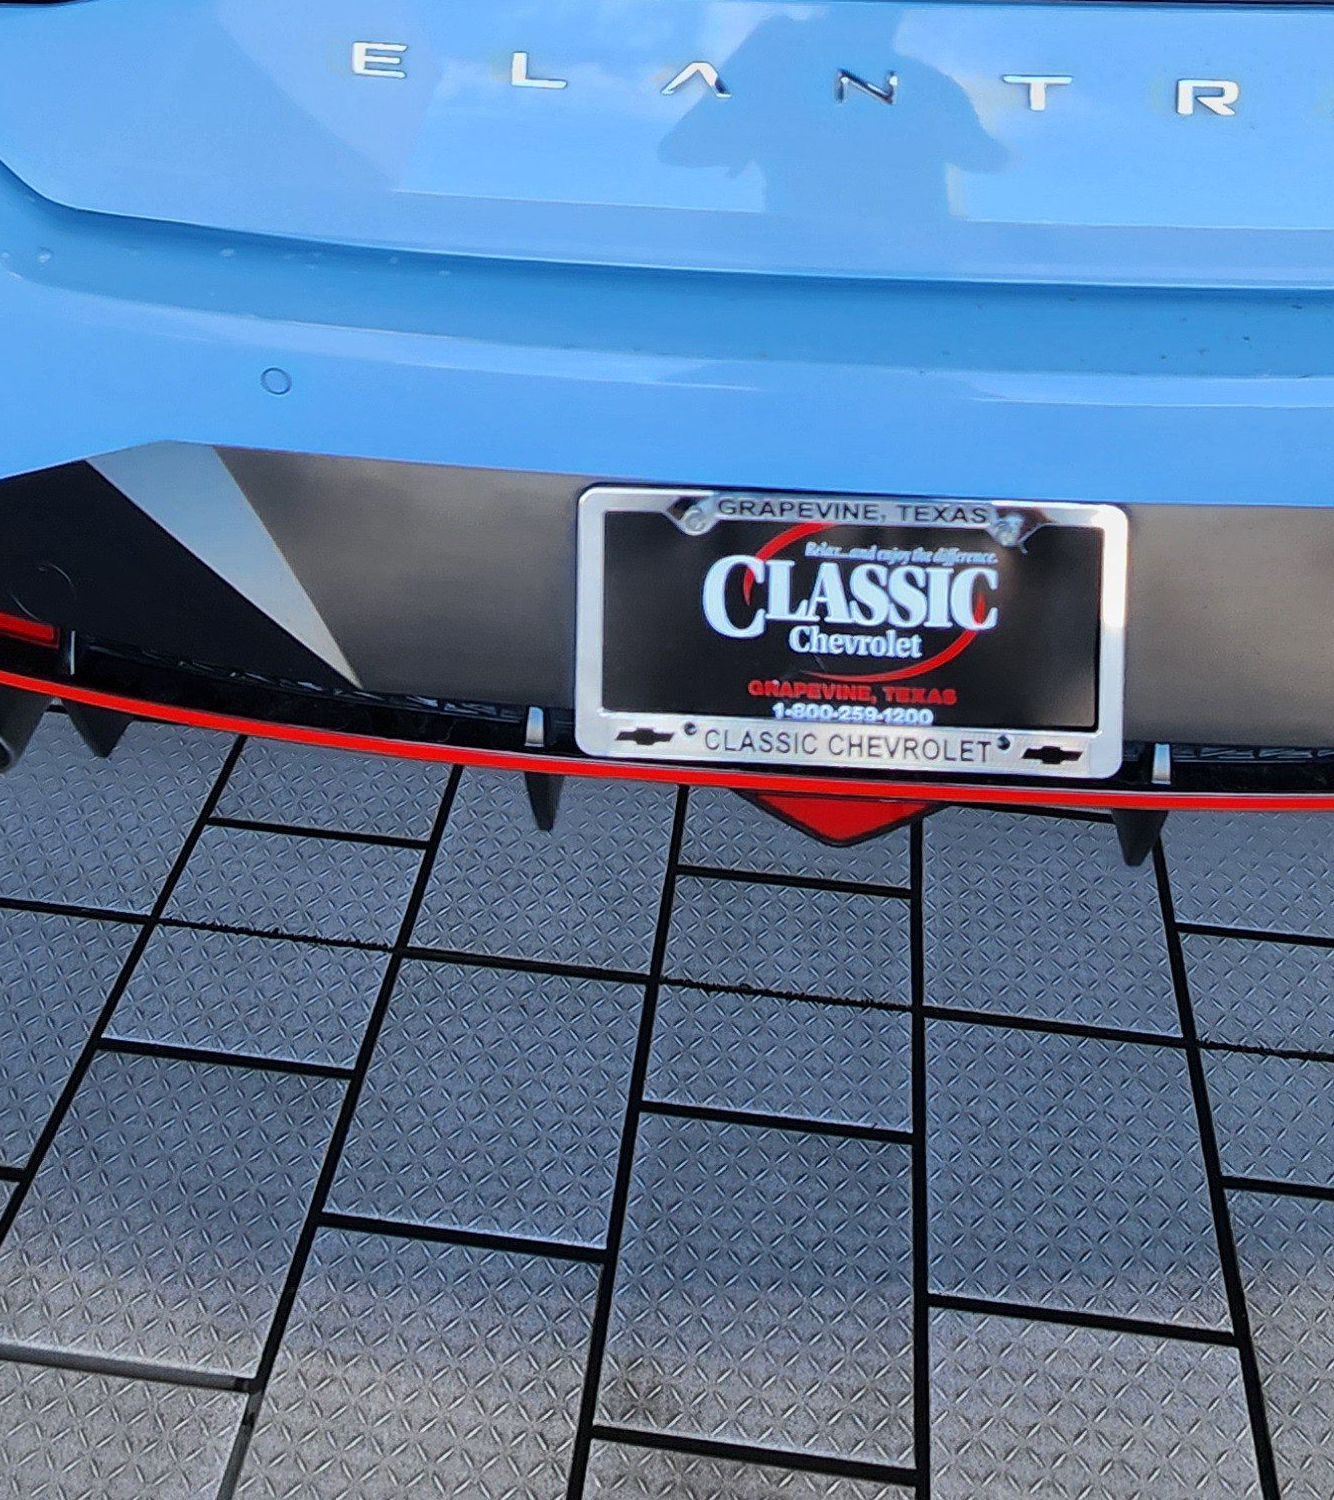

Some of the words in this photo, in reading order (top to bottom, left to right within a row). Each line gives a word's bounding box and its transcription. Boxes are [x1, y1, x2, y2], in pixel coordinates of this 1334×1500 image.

[717, 498, 887, 521] GRAPEVINE,
[896, 503, 988, 524] TEXAS
[703, 554, 999, 638] CLASSIC
[788, 625, 923, 659] Chevrolet
[747, 679, 877, 704] GRAPEVINE,
[882, 685, 958, 706] TEXAS
[771, 701, 934, 726] 1-800-259-1200
[704, 729, 818, 755] CLASSIC
[827, 733, 992, 763] CHEVROLET
